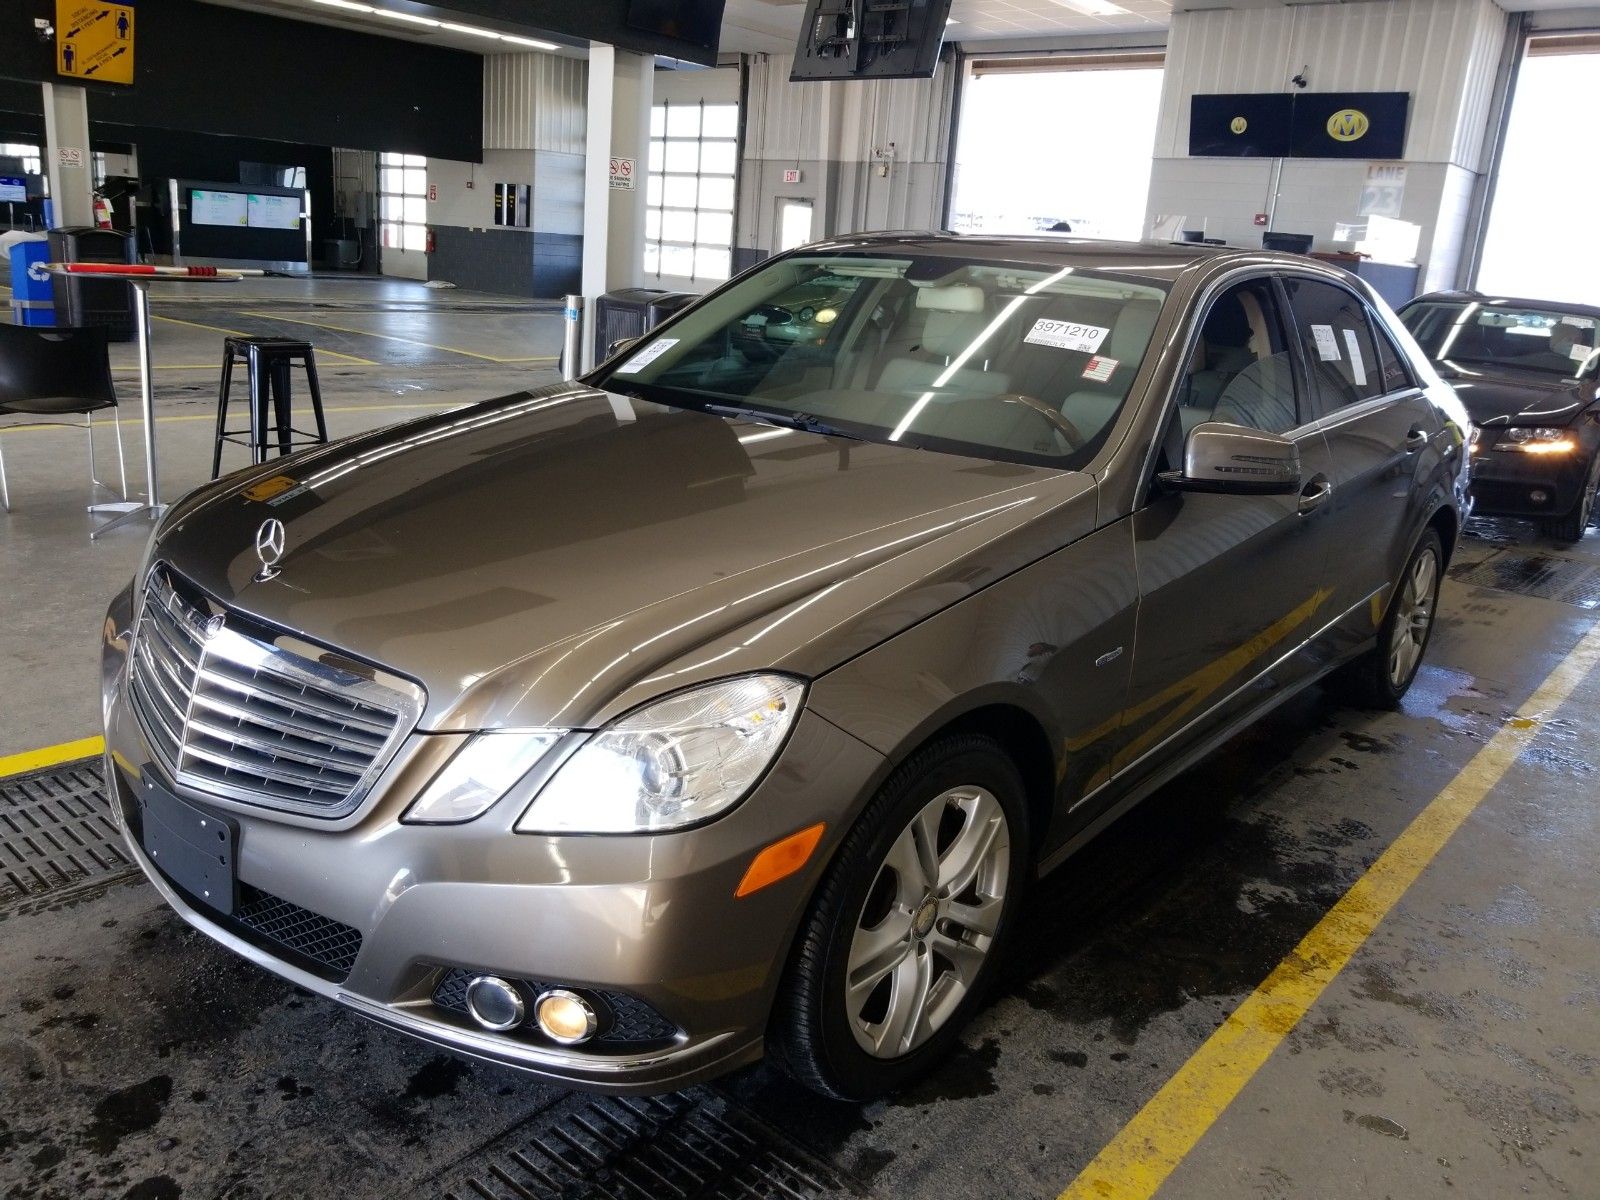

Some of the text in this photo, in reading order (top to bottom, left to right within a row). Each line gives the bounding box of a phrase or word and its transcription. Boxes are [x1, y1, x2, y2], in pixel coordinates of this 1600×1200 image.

[1367, 165, 1405, 180] LANE
[1363, 187, 1396, 212] 23
[1034, 321, 1099, 340] 3971210
